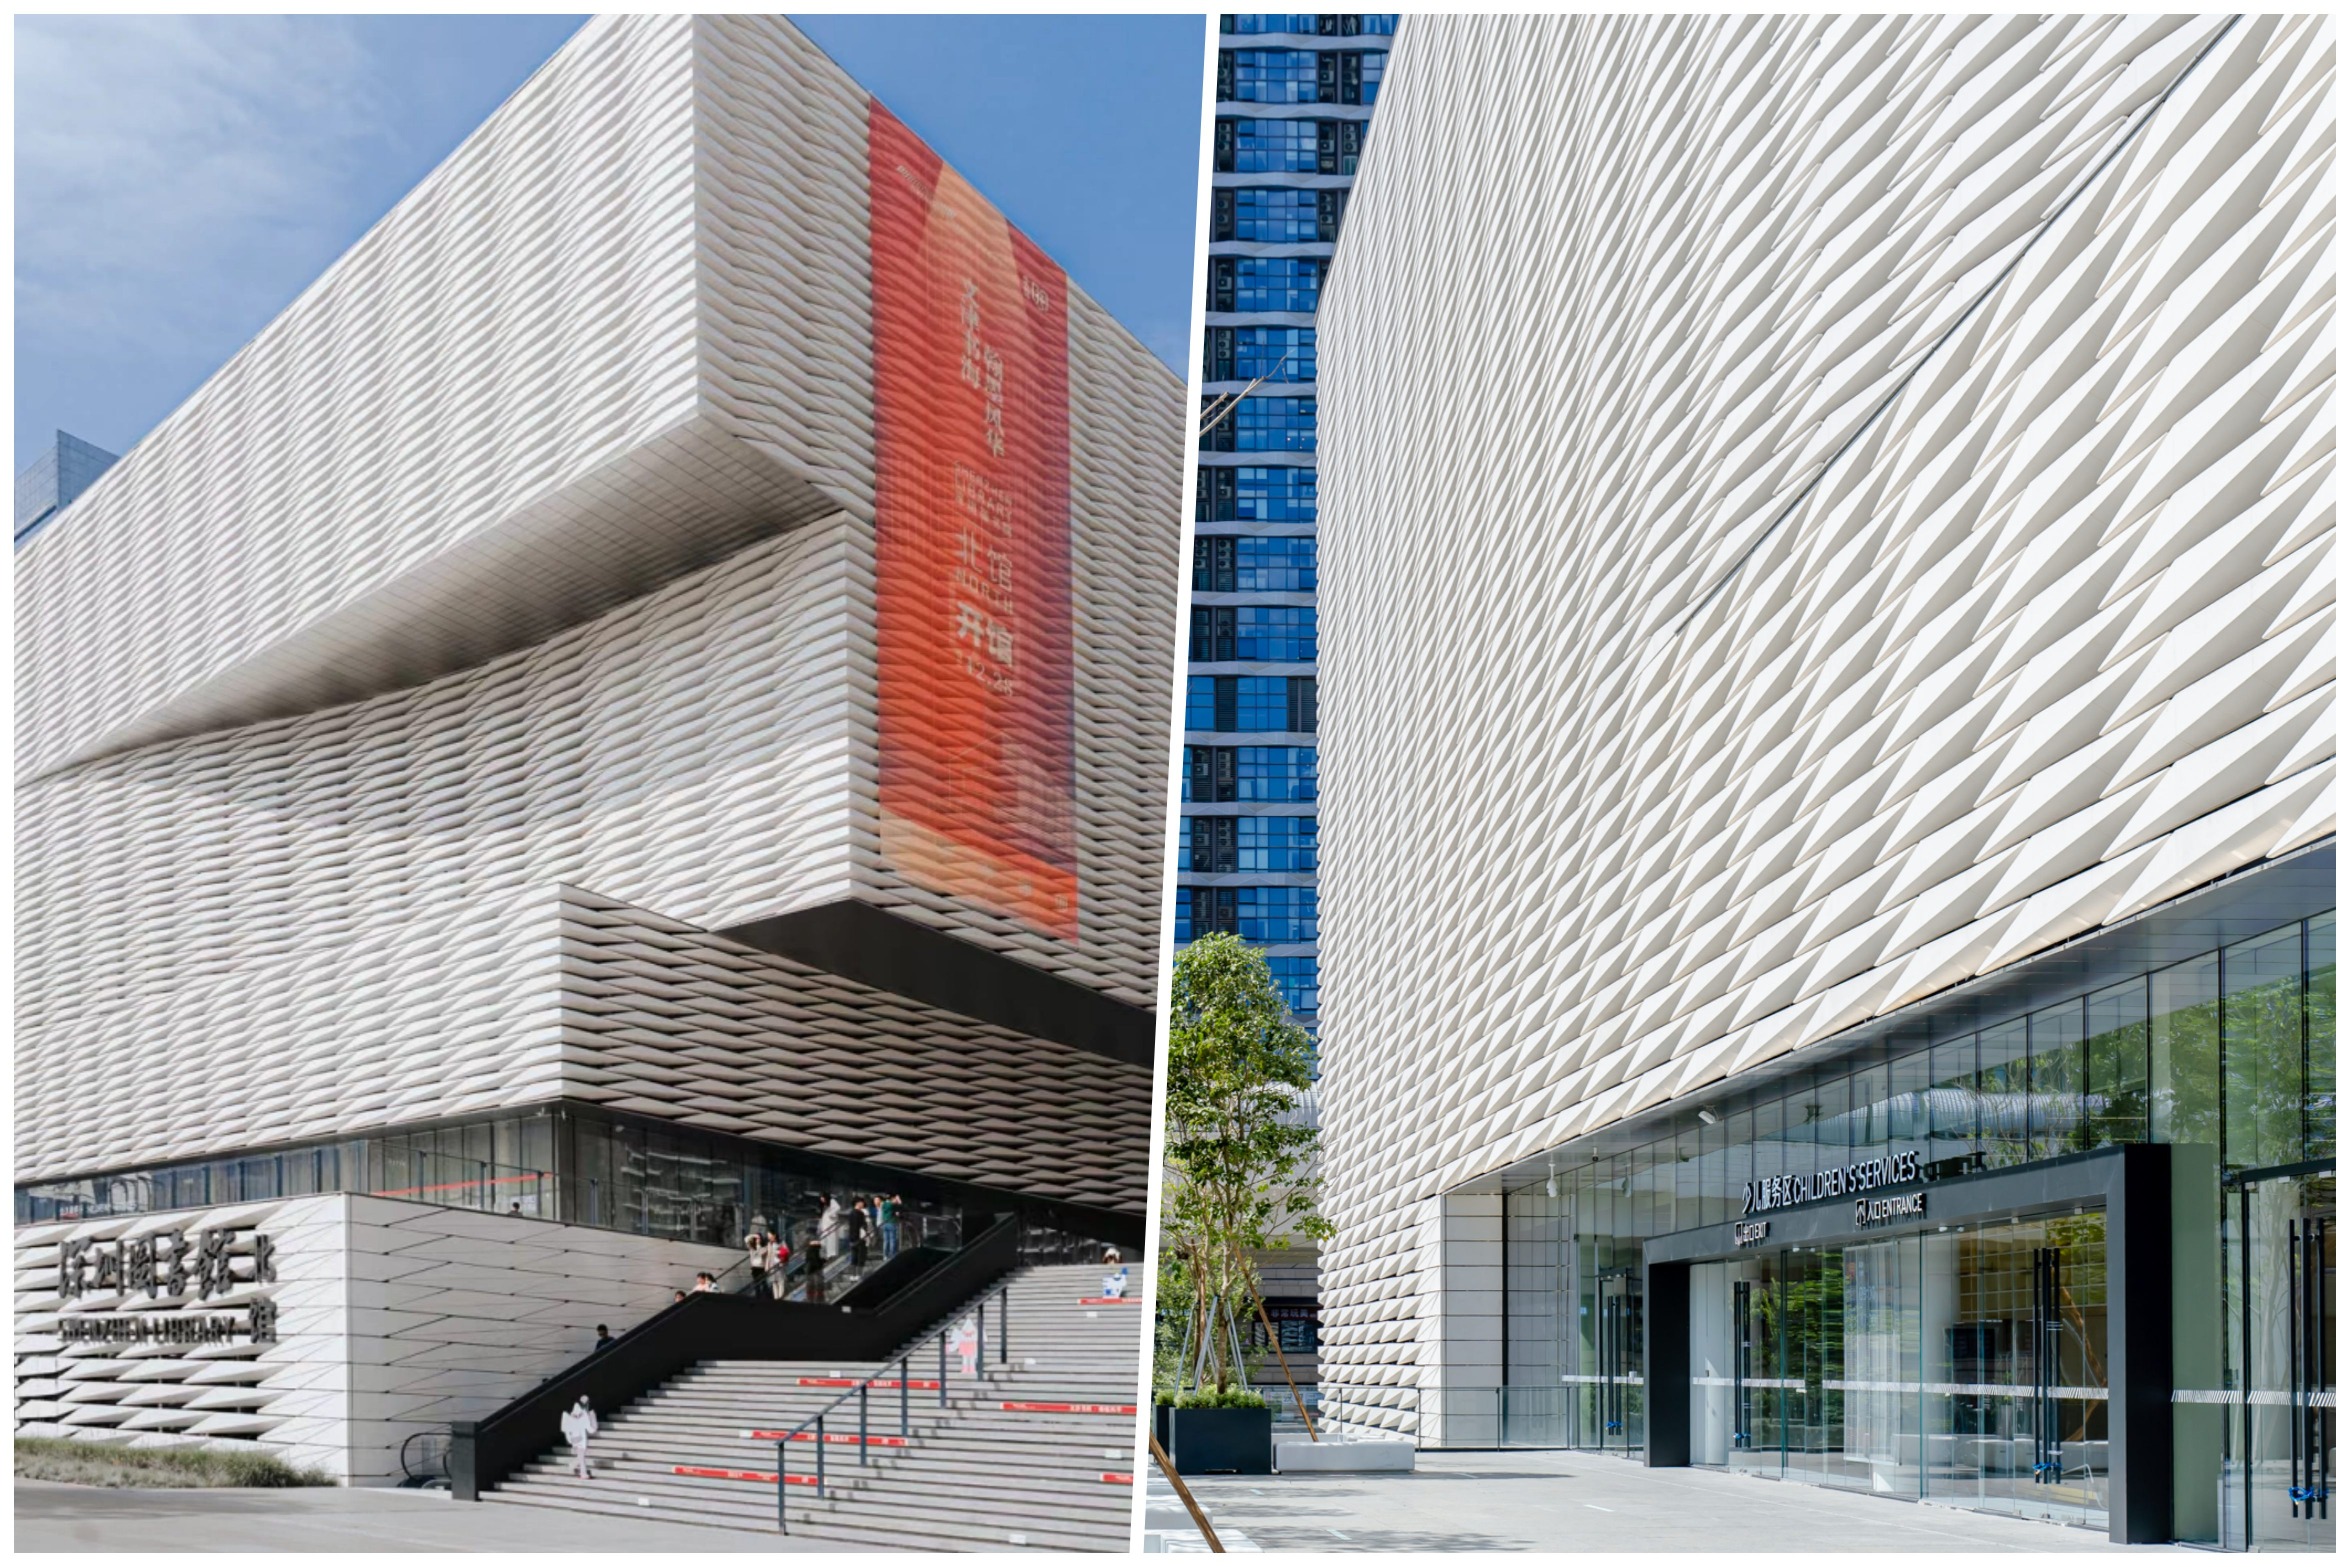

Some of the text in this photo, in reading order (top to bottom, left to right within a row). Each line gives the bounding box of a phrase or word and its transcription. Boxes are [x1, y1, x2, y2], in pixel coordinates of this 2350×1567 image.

[955, 524, 1013, 593] 北馆
[955, 566, 1013, 616] NORTH
[956, 600, 1013, 668] 开馆
[1742, 1150, 1916, 1215] 少儿服务区 CHILDREN'S SERVICES
[1867, 1192, 1923, 1220] 入口 ENTRANCE
[1755, 1221, 1767, 1239] EXIT
[57, 1315, 236, 1345] SHENZHEN LIBRARY
